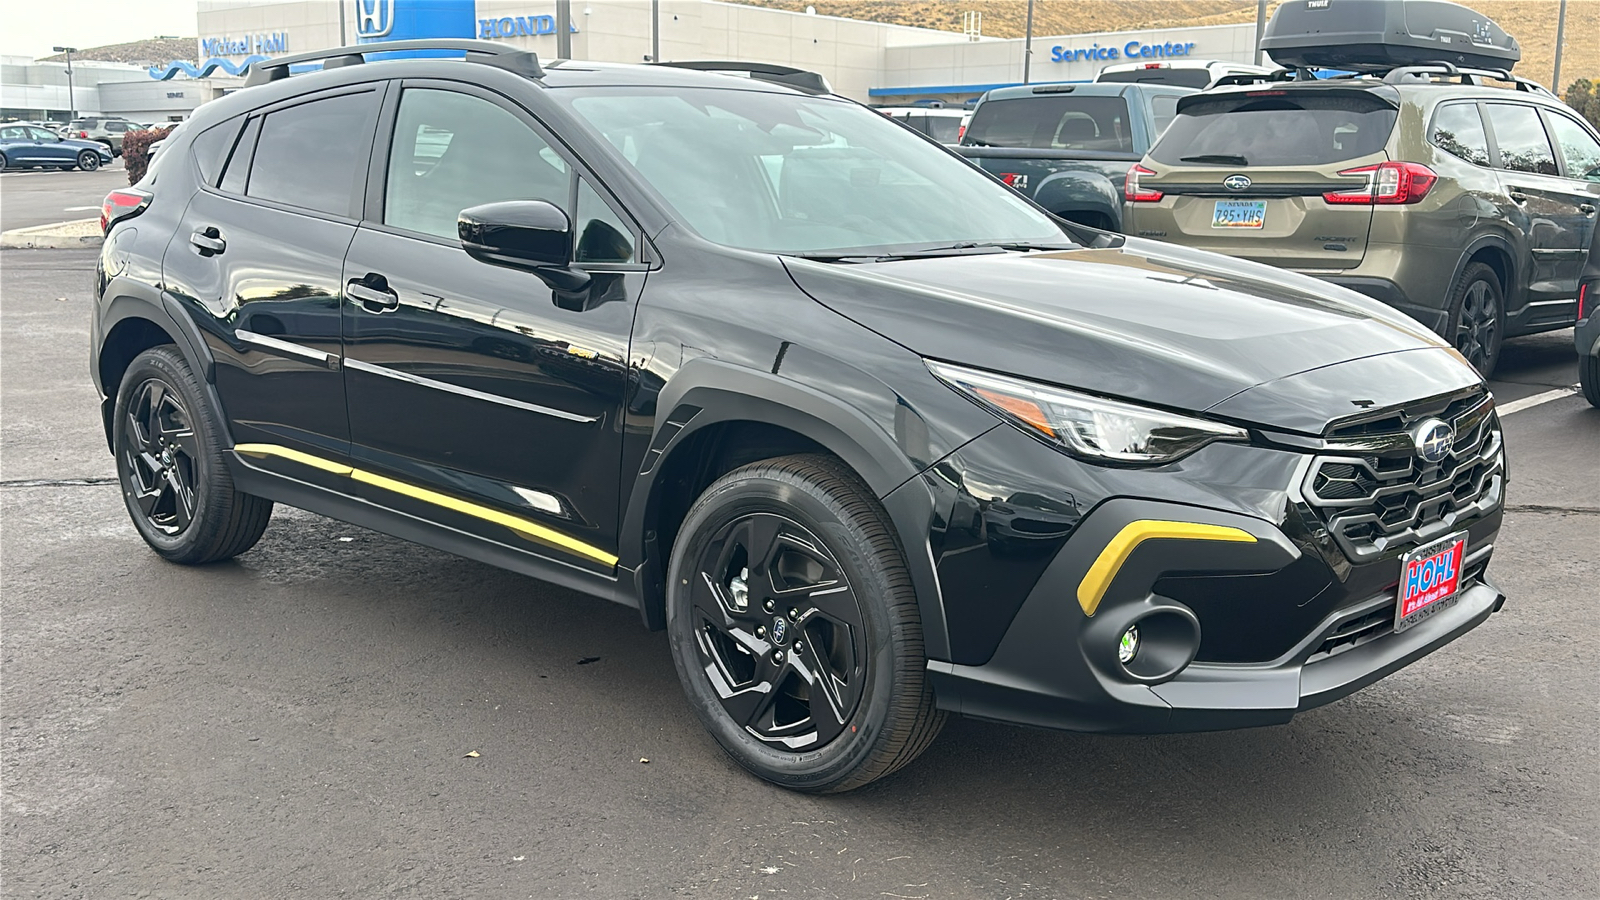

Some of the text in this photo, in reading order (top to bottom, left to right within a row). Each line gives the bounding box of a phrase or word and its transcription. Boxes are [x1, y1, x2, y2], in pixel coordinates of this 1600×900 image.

[1308, 0, 1329, 8] THULE
[478, 15, 579, 39] HOND
[202, 33, 286, 56] Michael Hohl
[1051, 41, 1195, 63] Service Center
[1216, 210, 1262, 223] 795 YHS
[1404, 551, 1454, 600] HOHL
